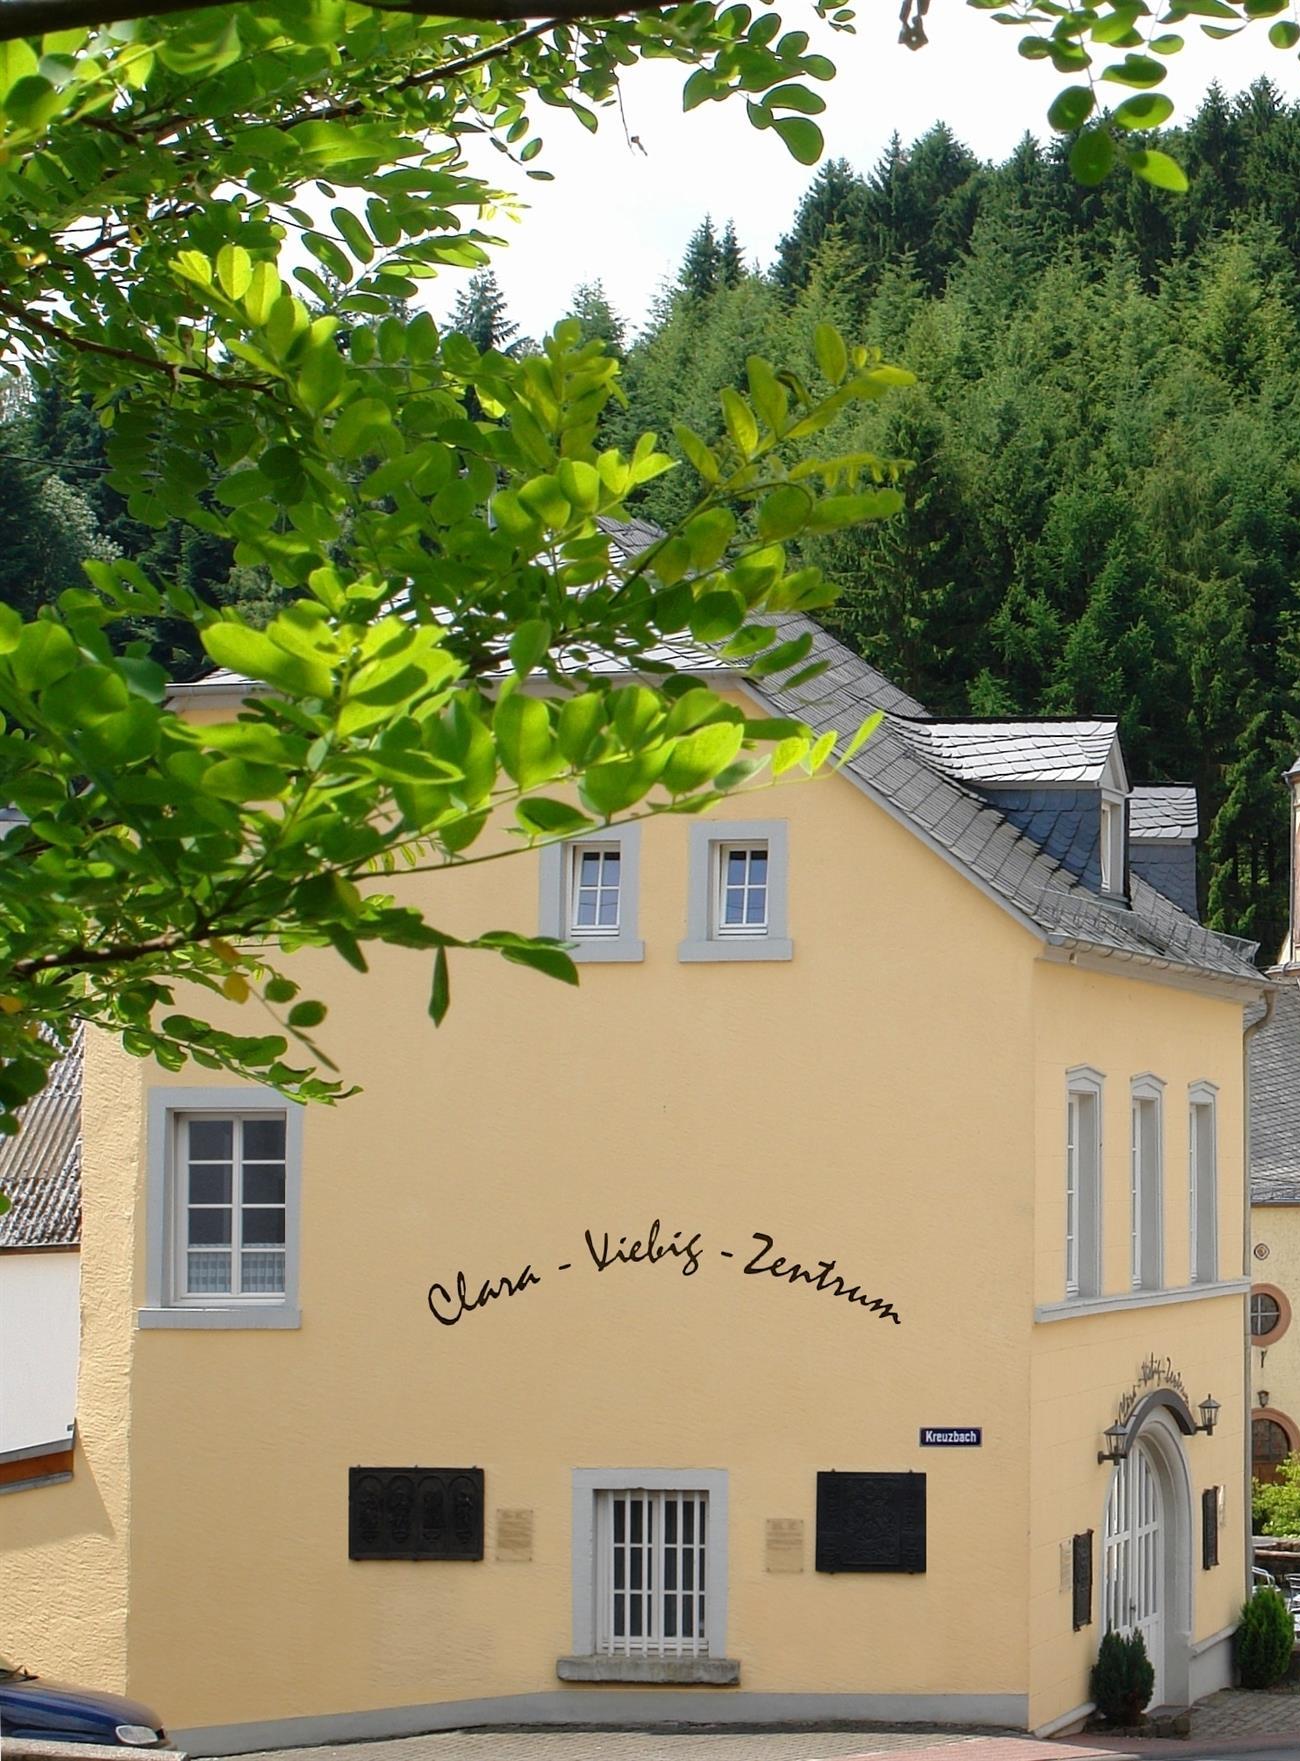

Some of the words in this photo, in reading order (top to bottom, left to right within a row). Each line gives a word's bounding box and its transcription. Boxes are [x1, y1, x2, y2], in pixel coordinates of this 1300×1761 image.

[427, 1264, 541, 1326] Clara
[584, 1218, 704, 1277] Viebig
[743, 1232, 902, 1325] Zentrum
[925, 1430, 977, 1443] Kreuzbach
